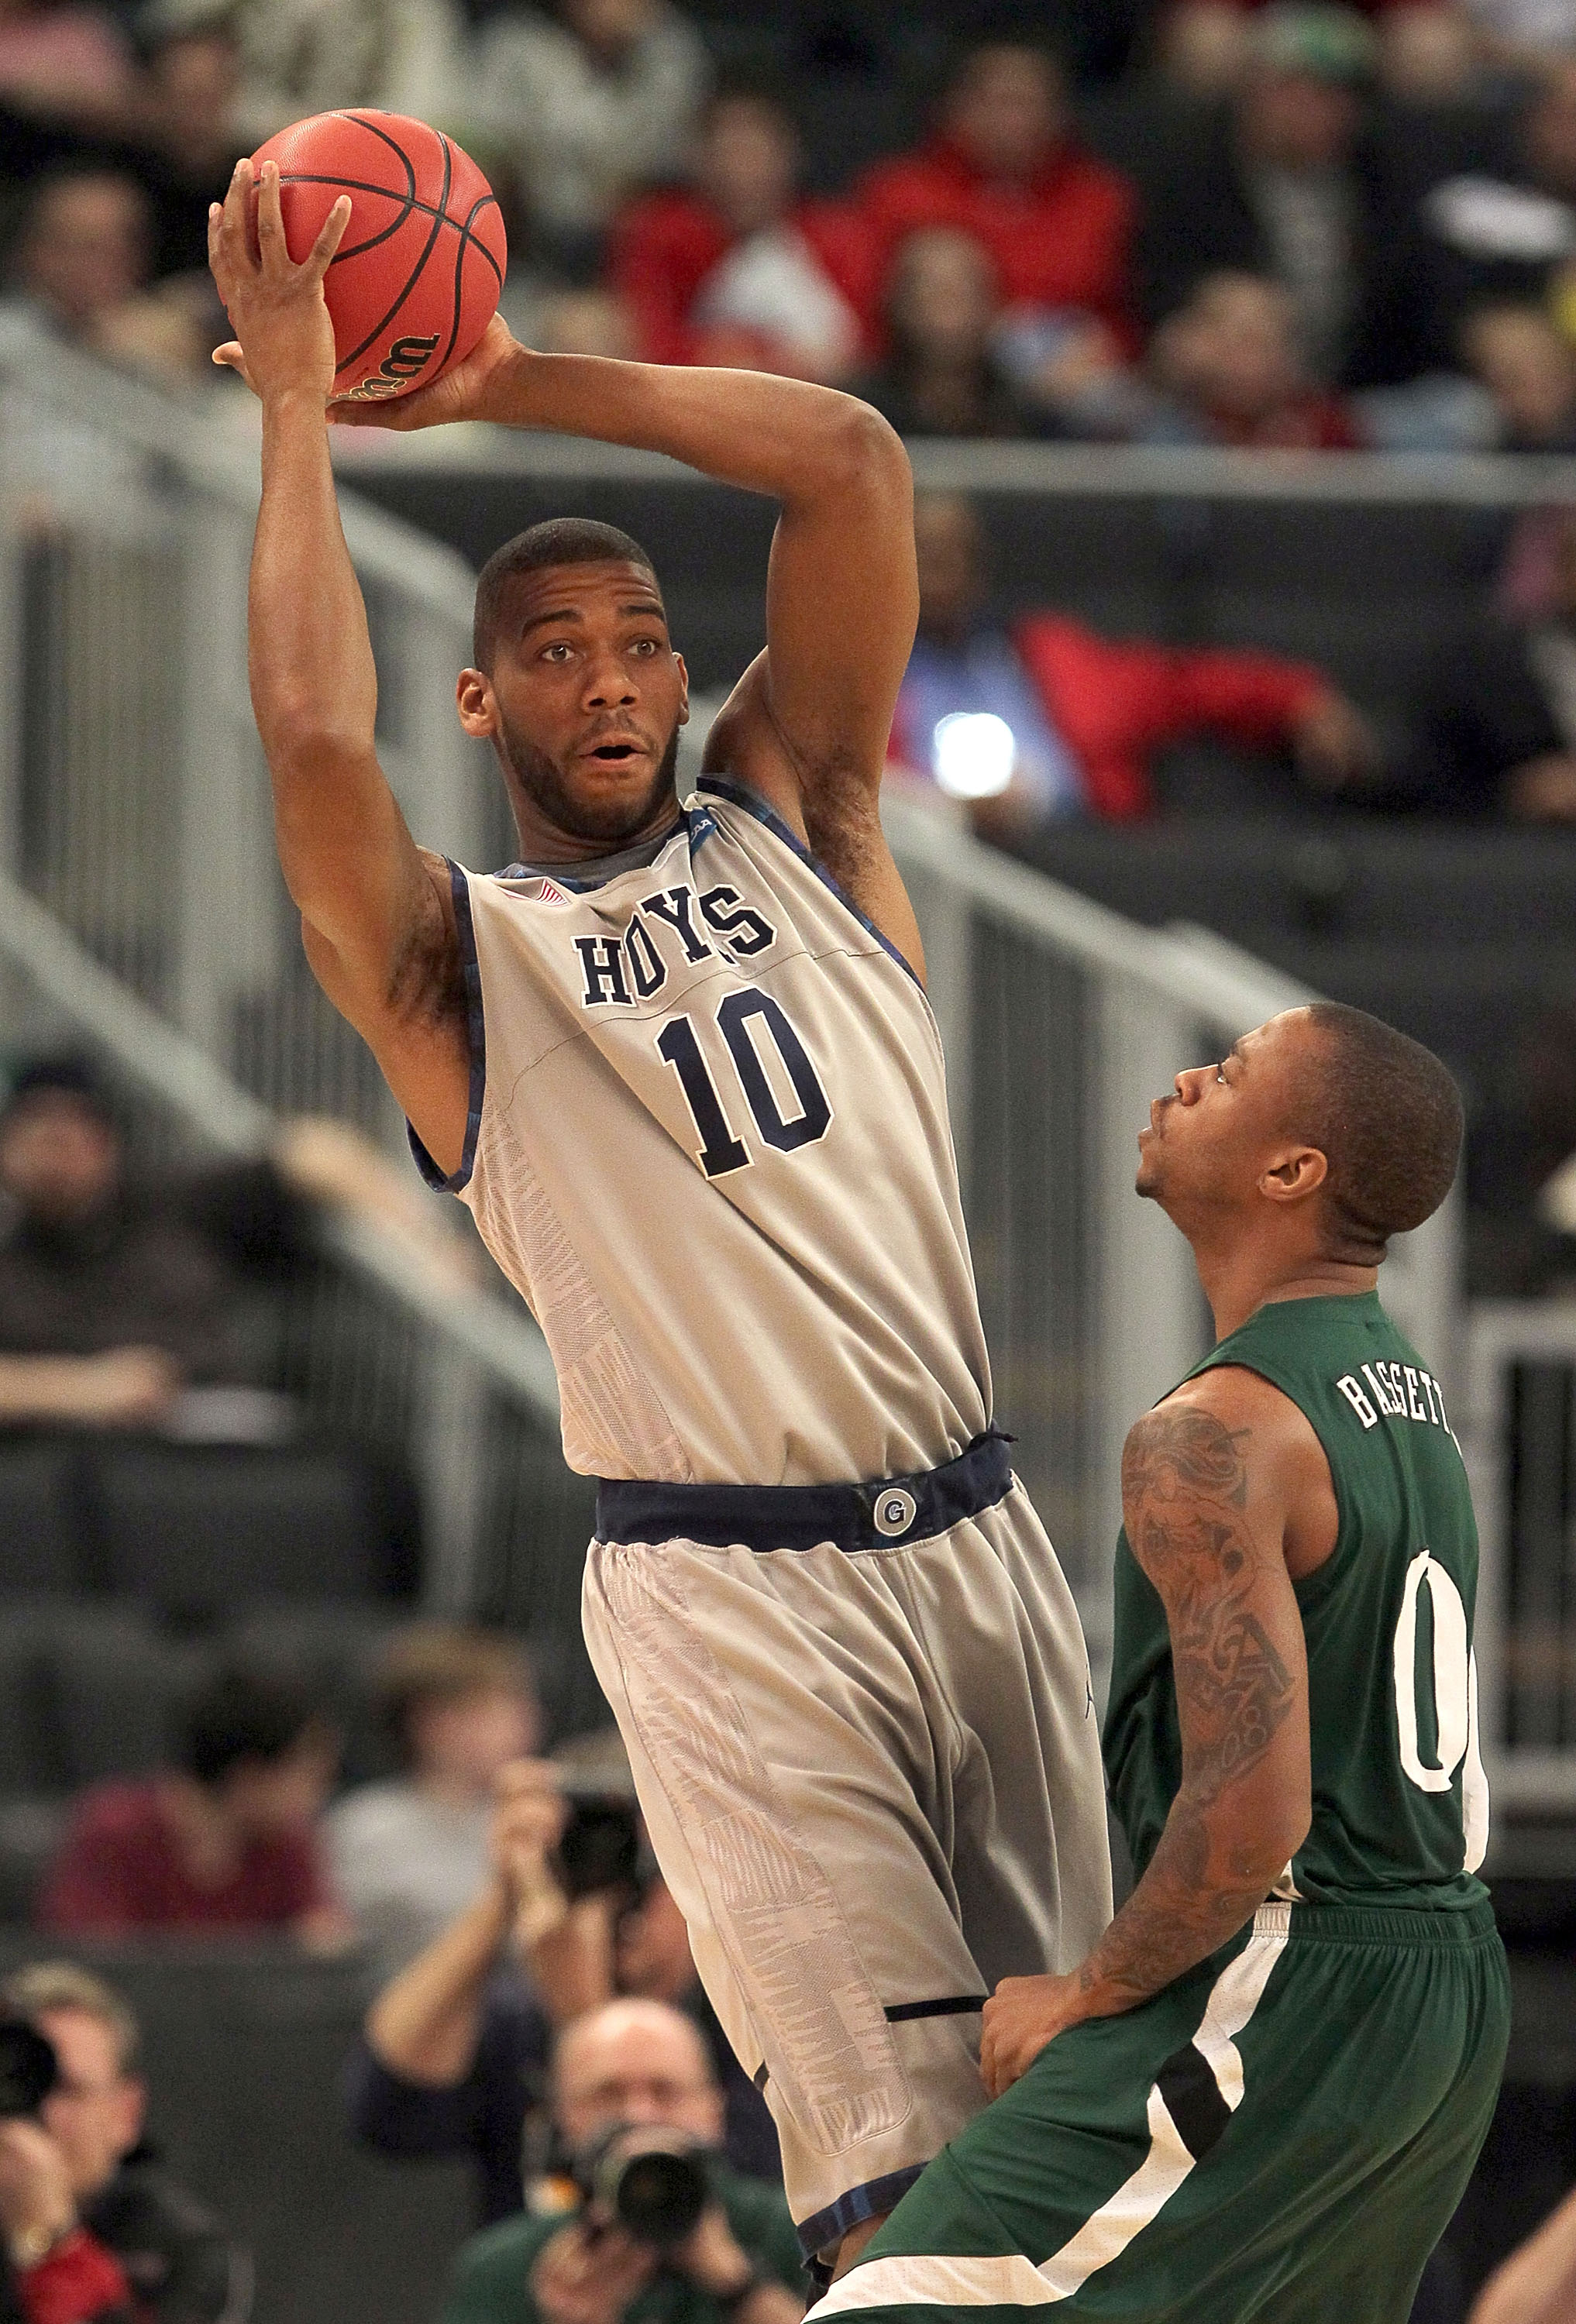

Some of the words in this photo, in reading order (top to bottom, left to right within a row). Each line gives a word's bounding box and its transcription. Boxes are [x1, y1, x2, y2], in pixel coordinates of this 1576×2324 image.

[570, 882, 778, 1009] HOYS
[655, 985, 835, 1181] 10
[884, 1499, 906, 1525] G
